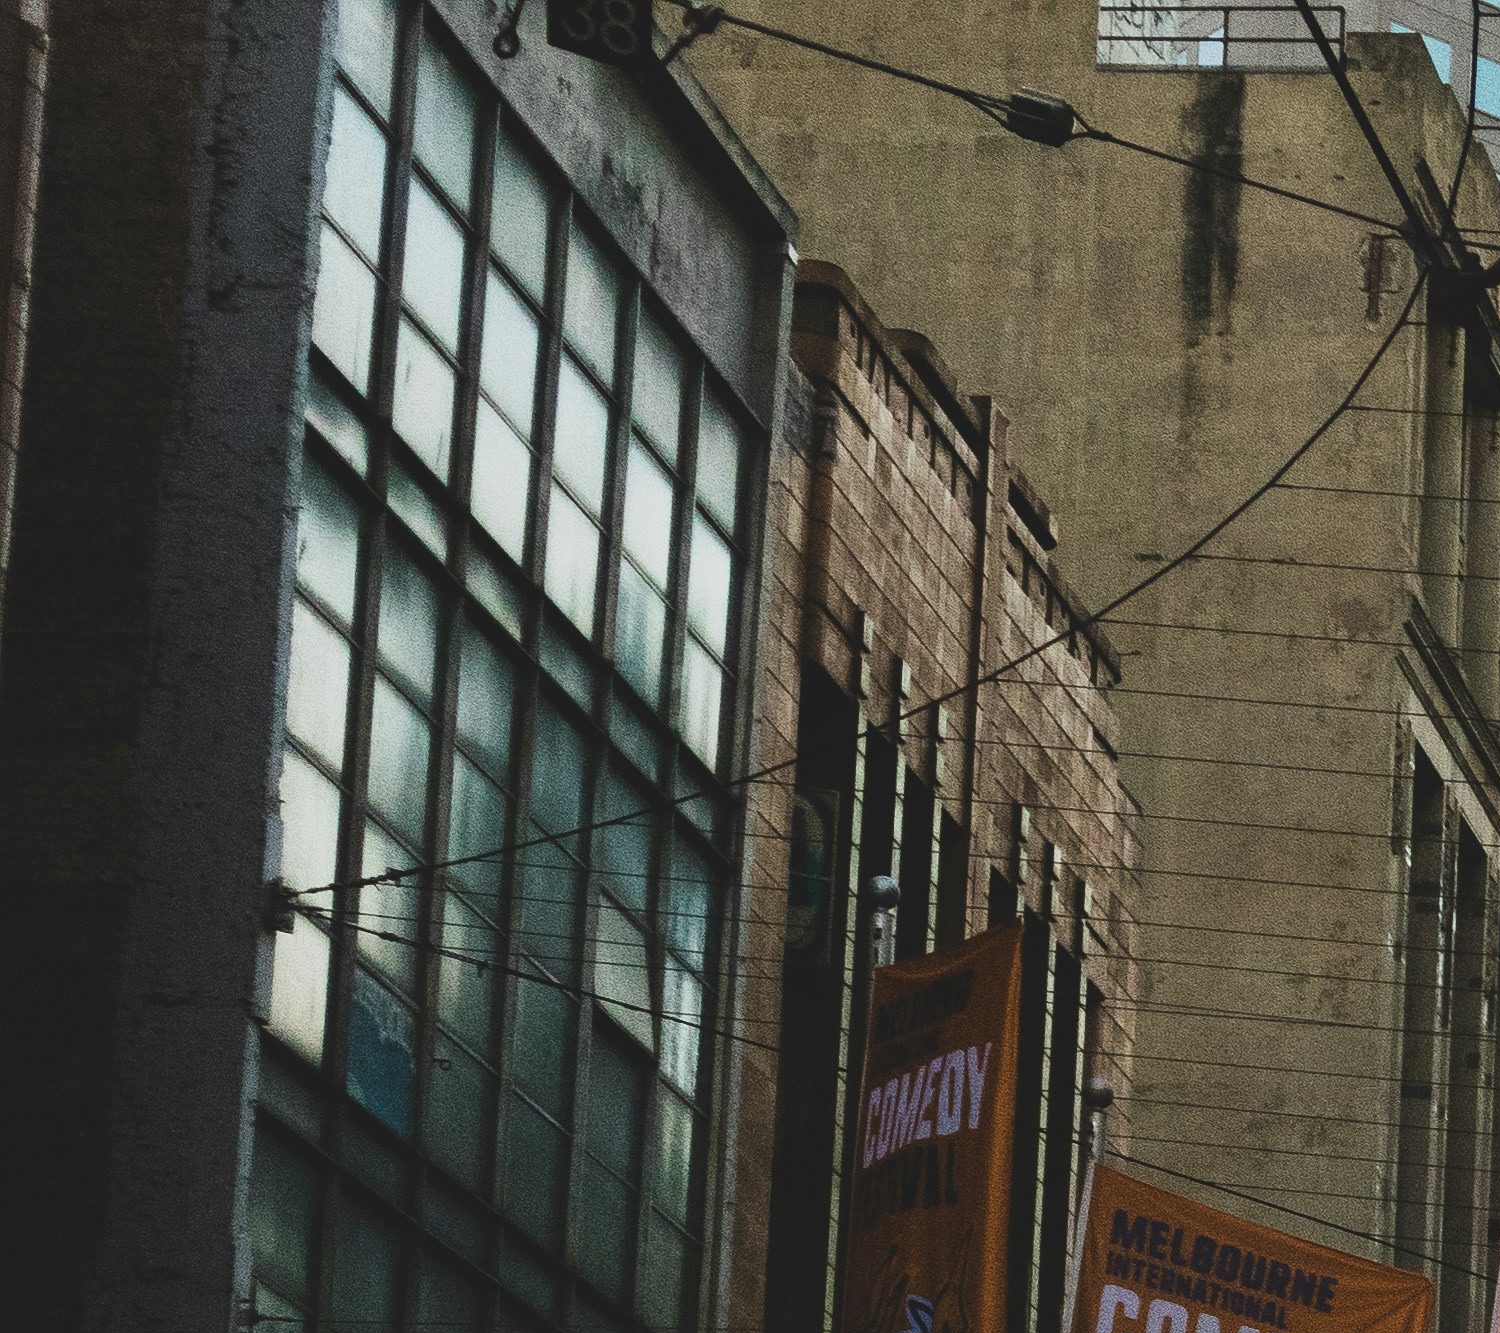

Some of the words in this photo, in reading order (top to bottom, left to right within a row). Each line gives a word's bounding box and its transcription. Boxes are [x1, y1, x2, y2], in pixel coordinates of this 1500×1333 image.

[863, 1042, 992, 1169] COMEDY
[1105, 1251, 1288, 1329] INTERNATIONAL
[1110, 1209, 1338, 1314] MELBOURNE
